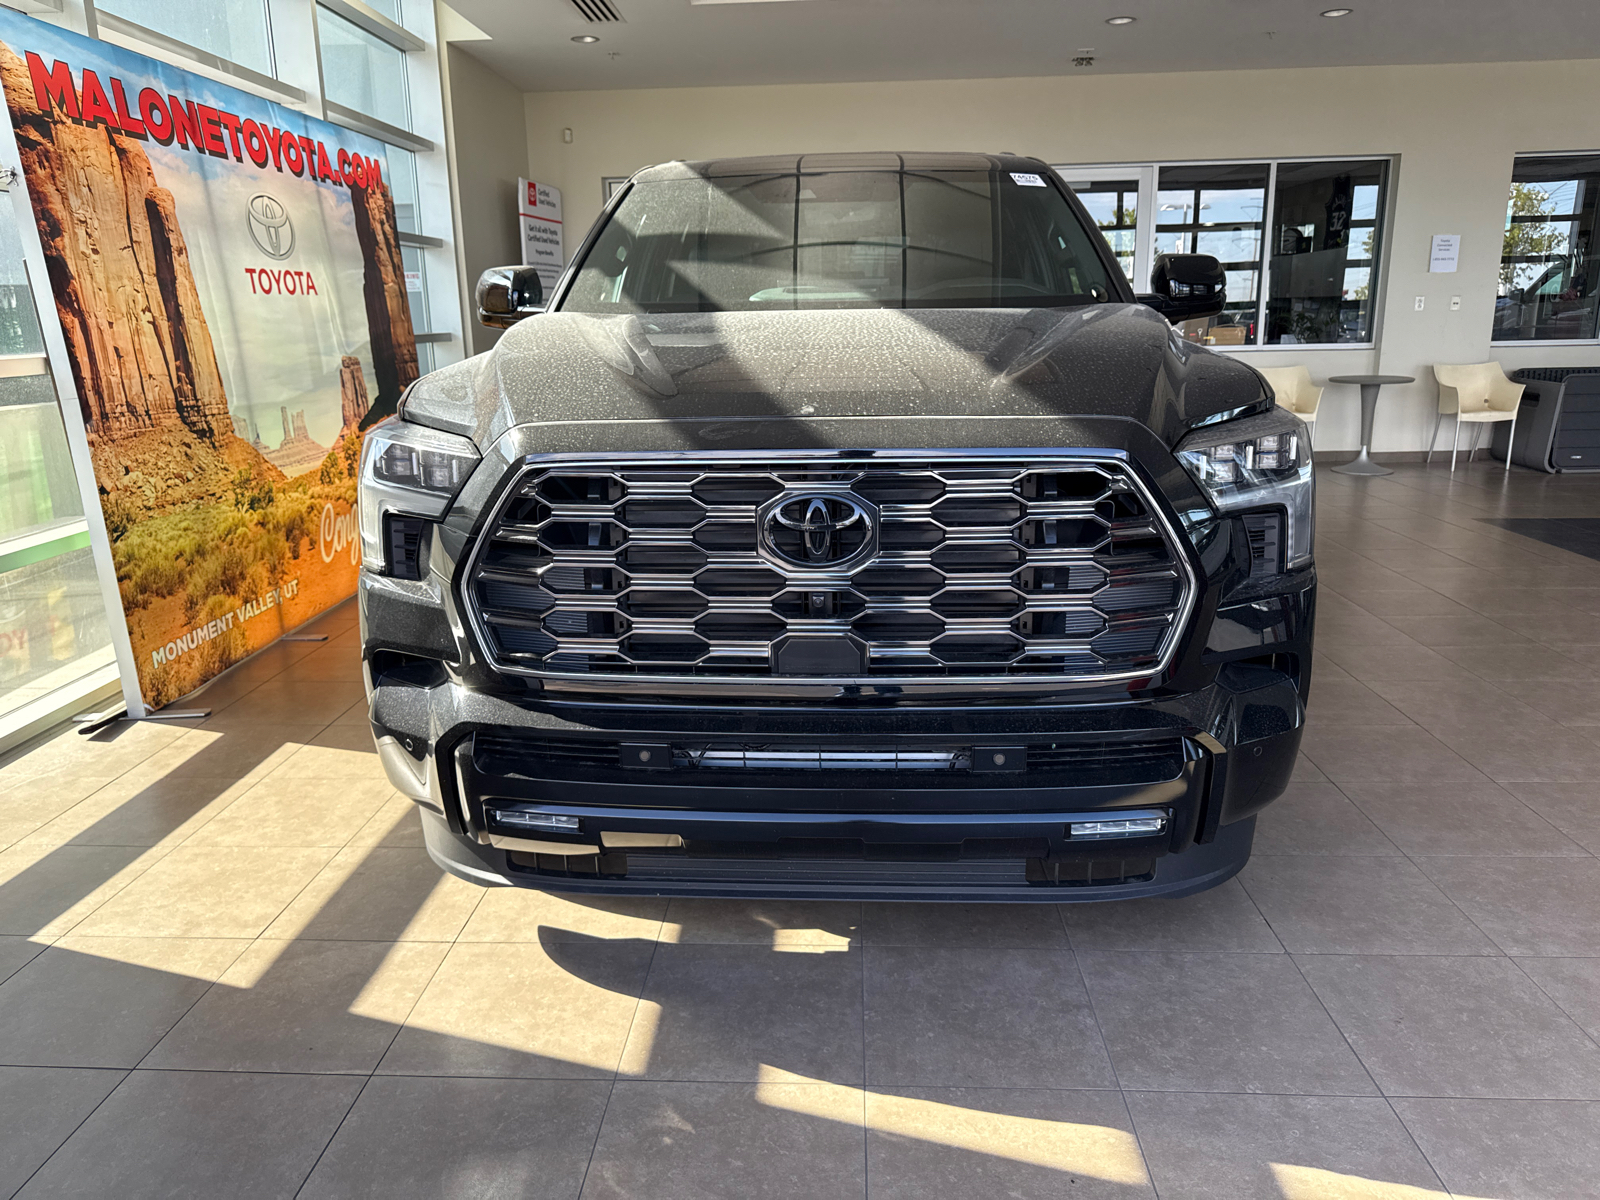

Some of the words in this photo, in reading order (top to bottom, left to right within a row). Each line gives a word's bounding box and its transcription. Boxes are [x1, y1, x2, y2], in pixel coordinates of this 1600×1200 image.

[24, 50, 384, 192] MALONETOYOTA.COM
[1330, 211, 1346, 231] 32
[244, 268, 318, 296] TOYOTA
[151, 611, 234, 669] MONUMENT
[236, 588, 283, 623] VALLEY,
[283, 579, 299, 598] UT
